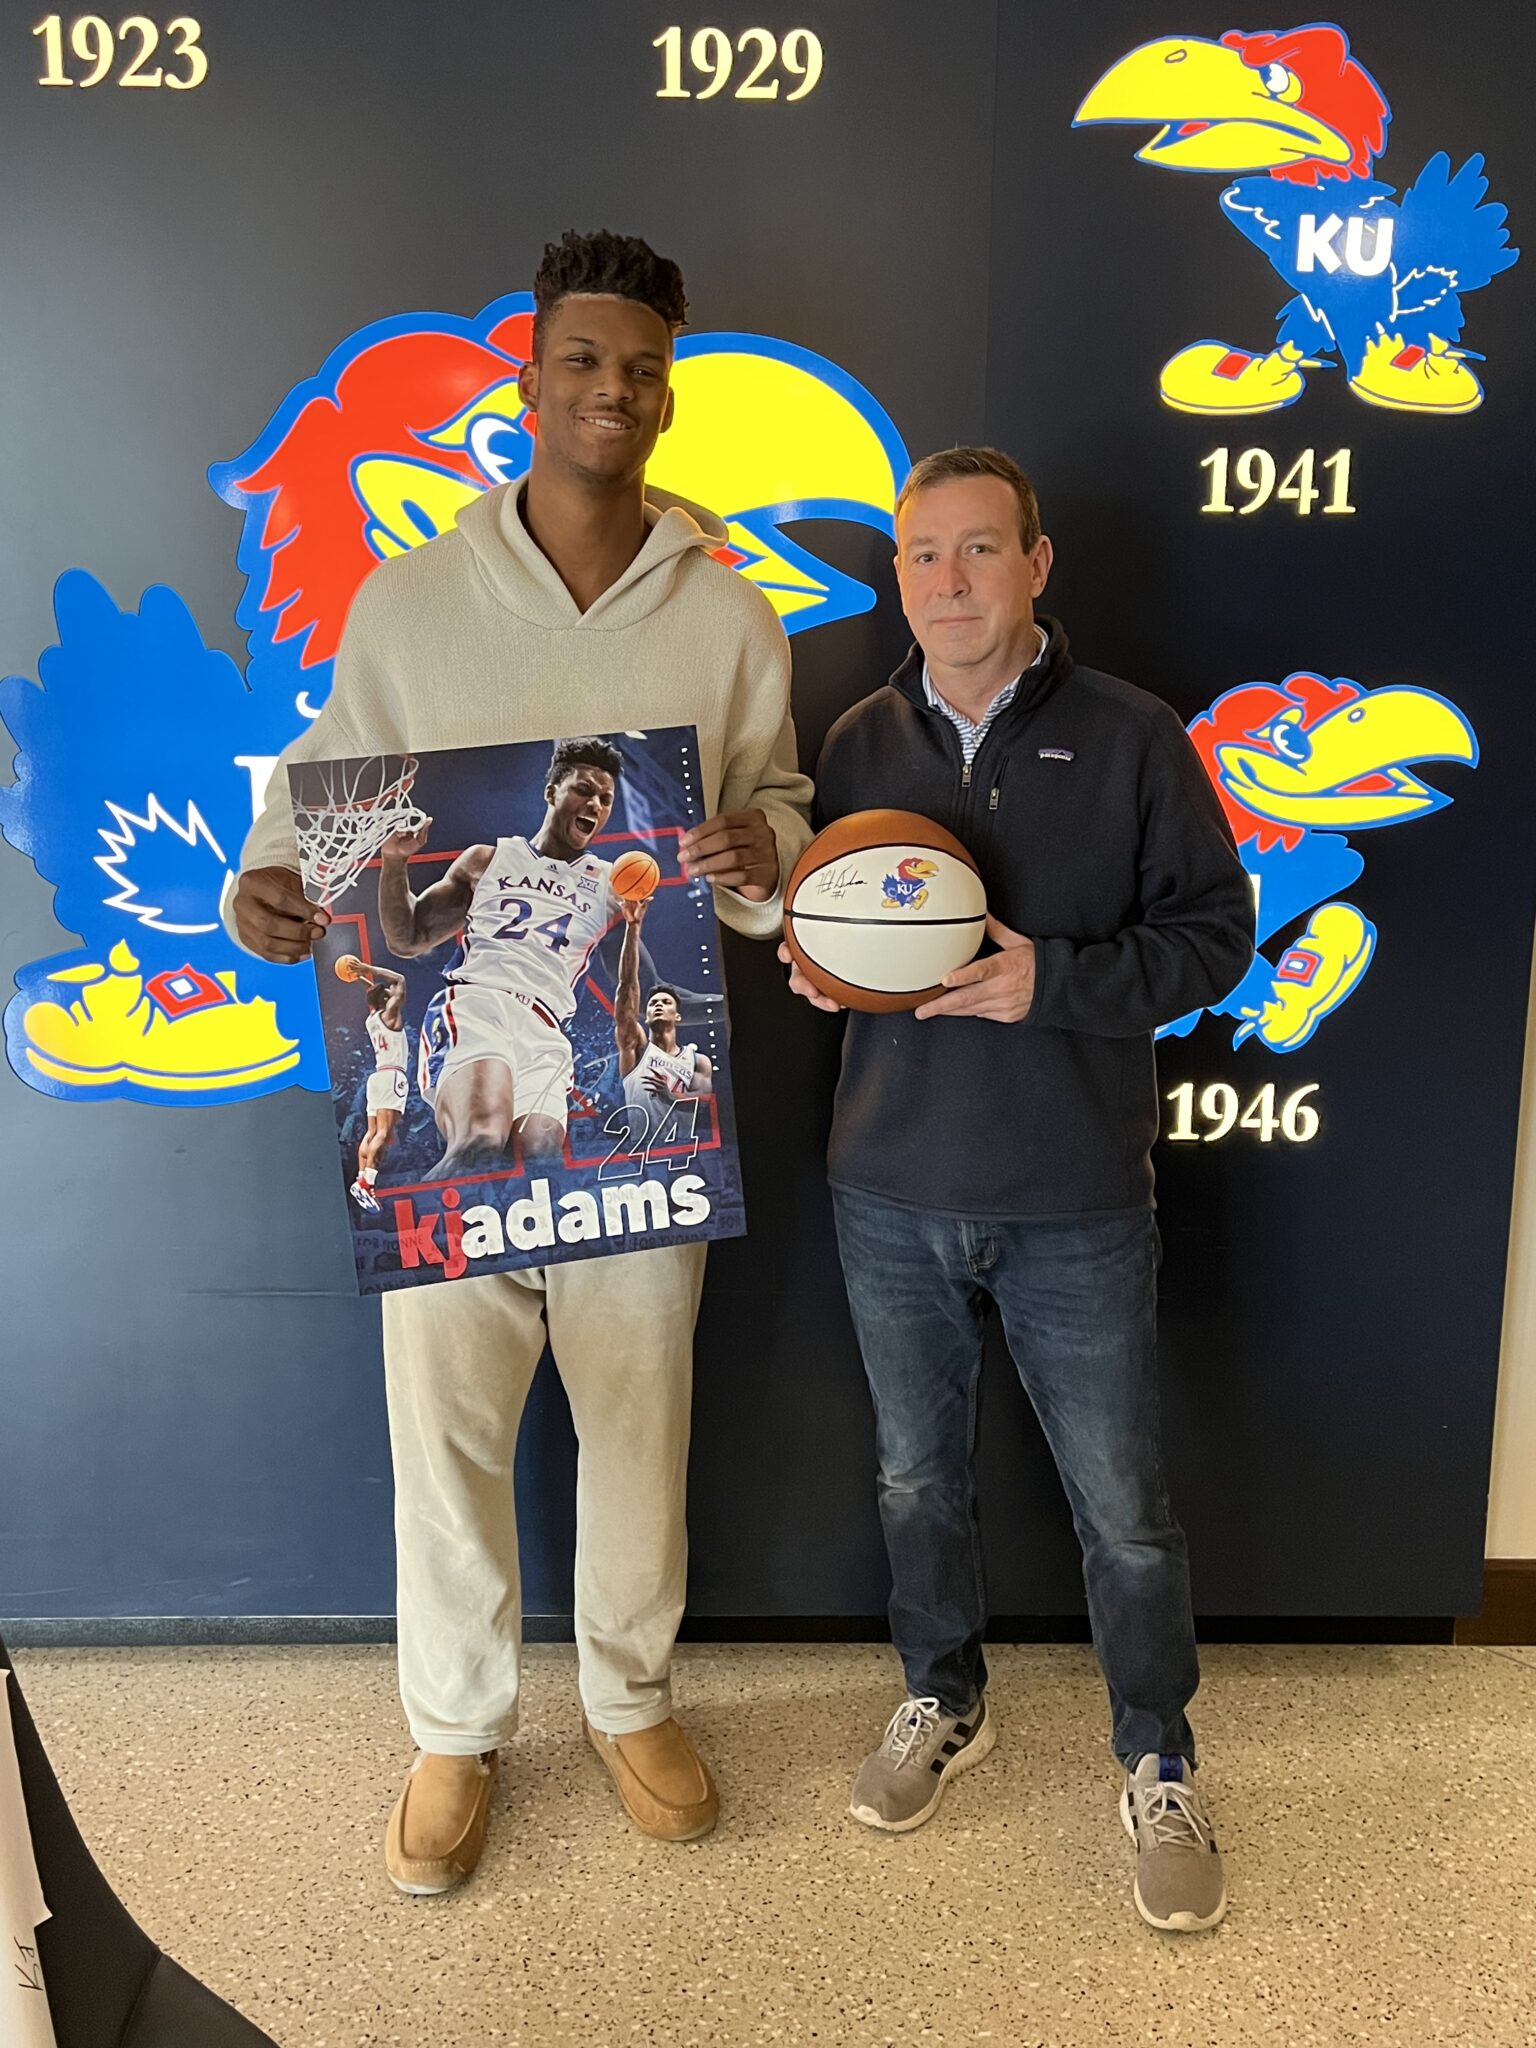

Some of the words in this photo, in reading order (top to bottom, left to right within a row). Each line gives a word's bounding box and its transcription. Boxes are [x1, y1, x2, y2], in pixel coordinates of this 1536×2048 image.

[33, 15, 208, 89] 1923
[652, 27, 824, 100] 1929
[1296, 213, 1394, 277] KU
[1200, 447, 1357, 515] 1941
[497, 876, 592, 913] KANSAS
[897, 883, 913, 896] KU
[492, 898, 573, 957] 24
[515, 992, 531, 1006] KU
[598, 1096, 699, 1181] 24
[1166, 1082, 1320, 1142] 1946
